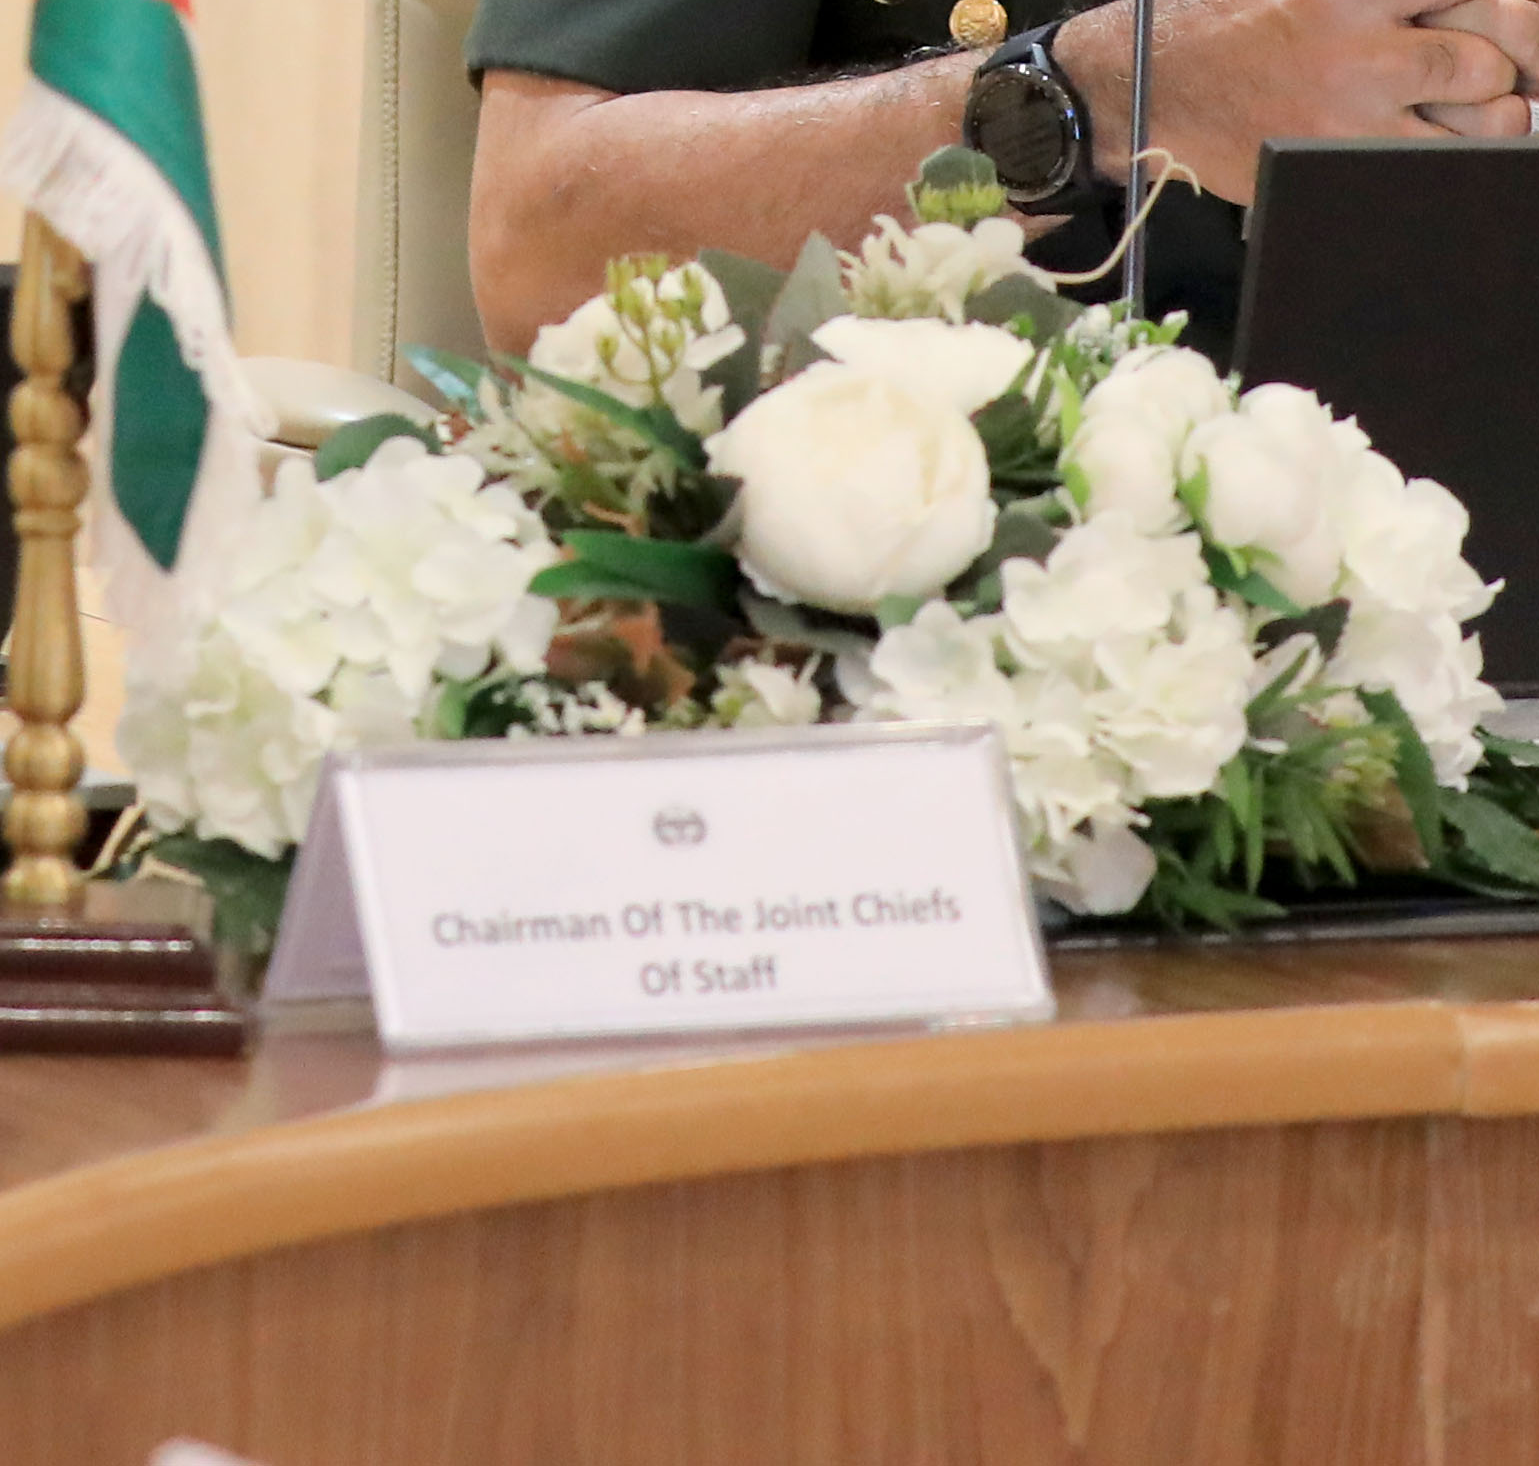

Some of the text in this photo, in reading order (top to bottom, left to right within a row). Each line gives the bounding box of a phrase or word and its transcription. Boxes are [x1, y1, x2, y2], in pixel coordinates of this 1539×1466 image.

[432, 886, 963, 947] Chairman Of The Joint Chiefs
[638, 953, 777, 997] Of Staff
